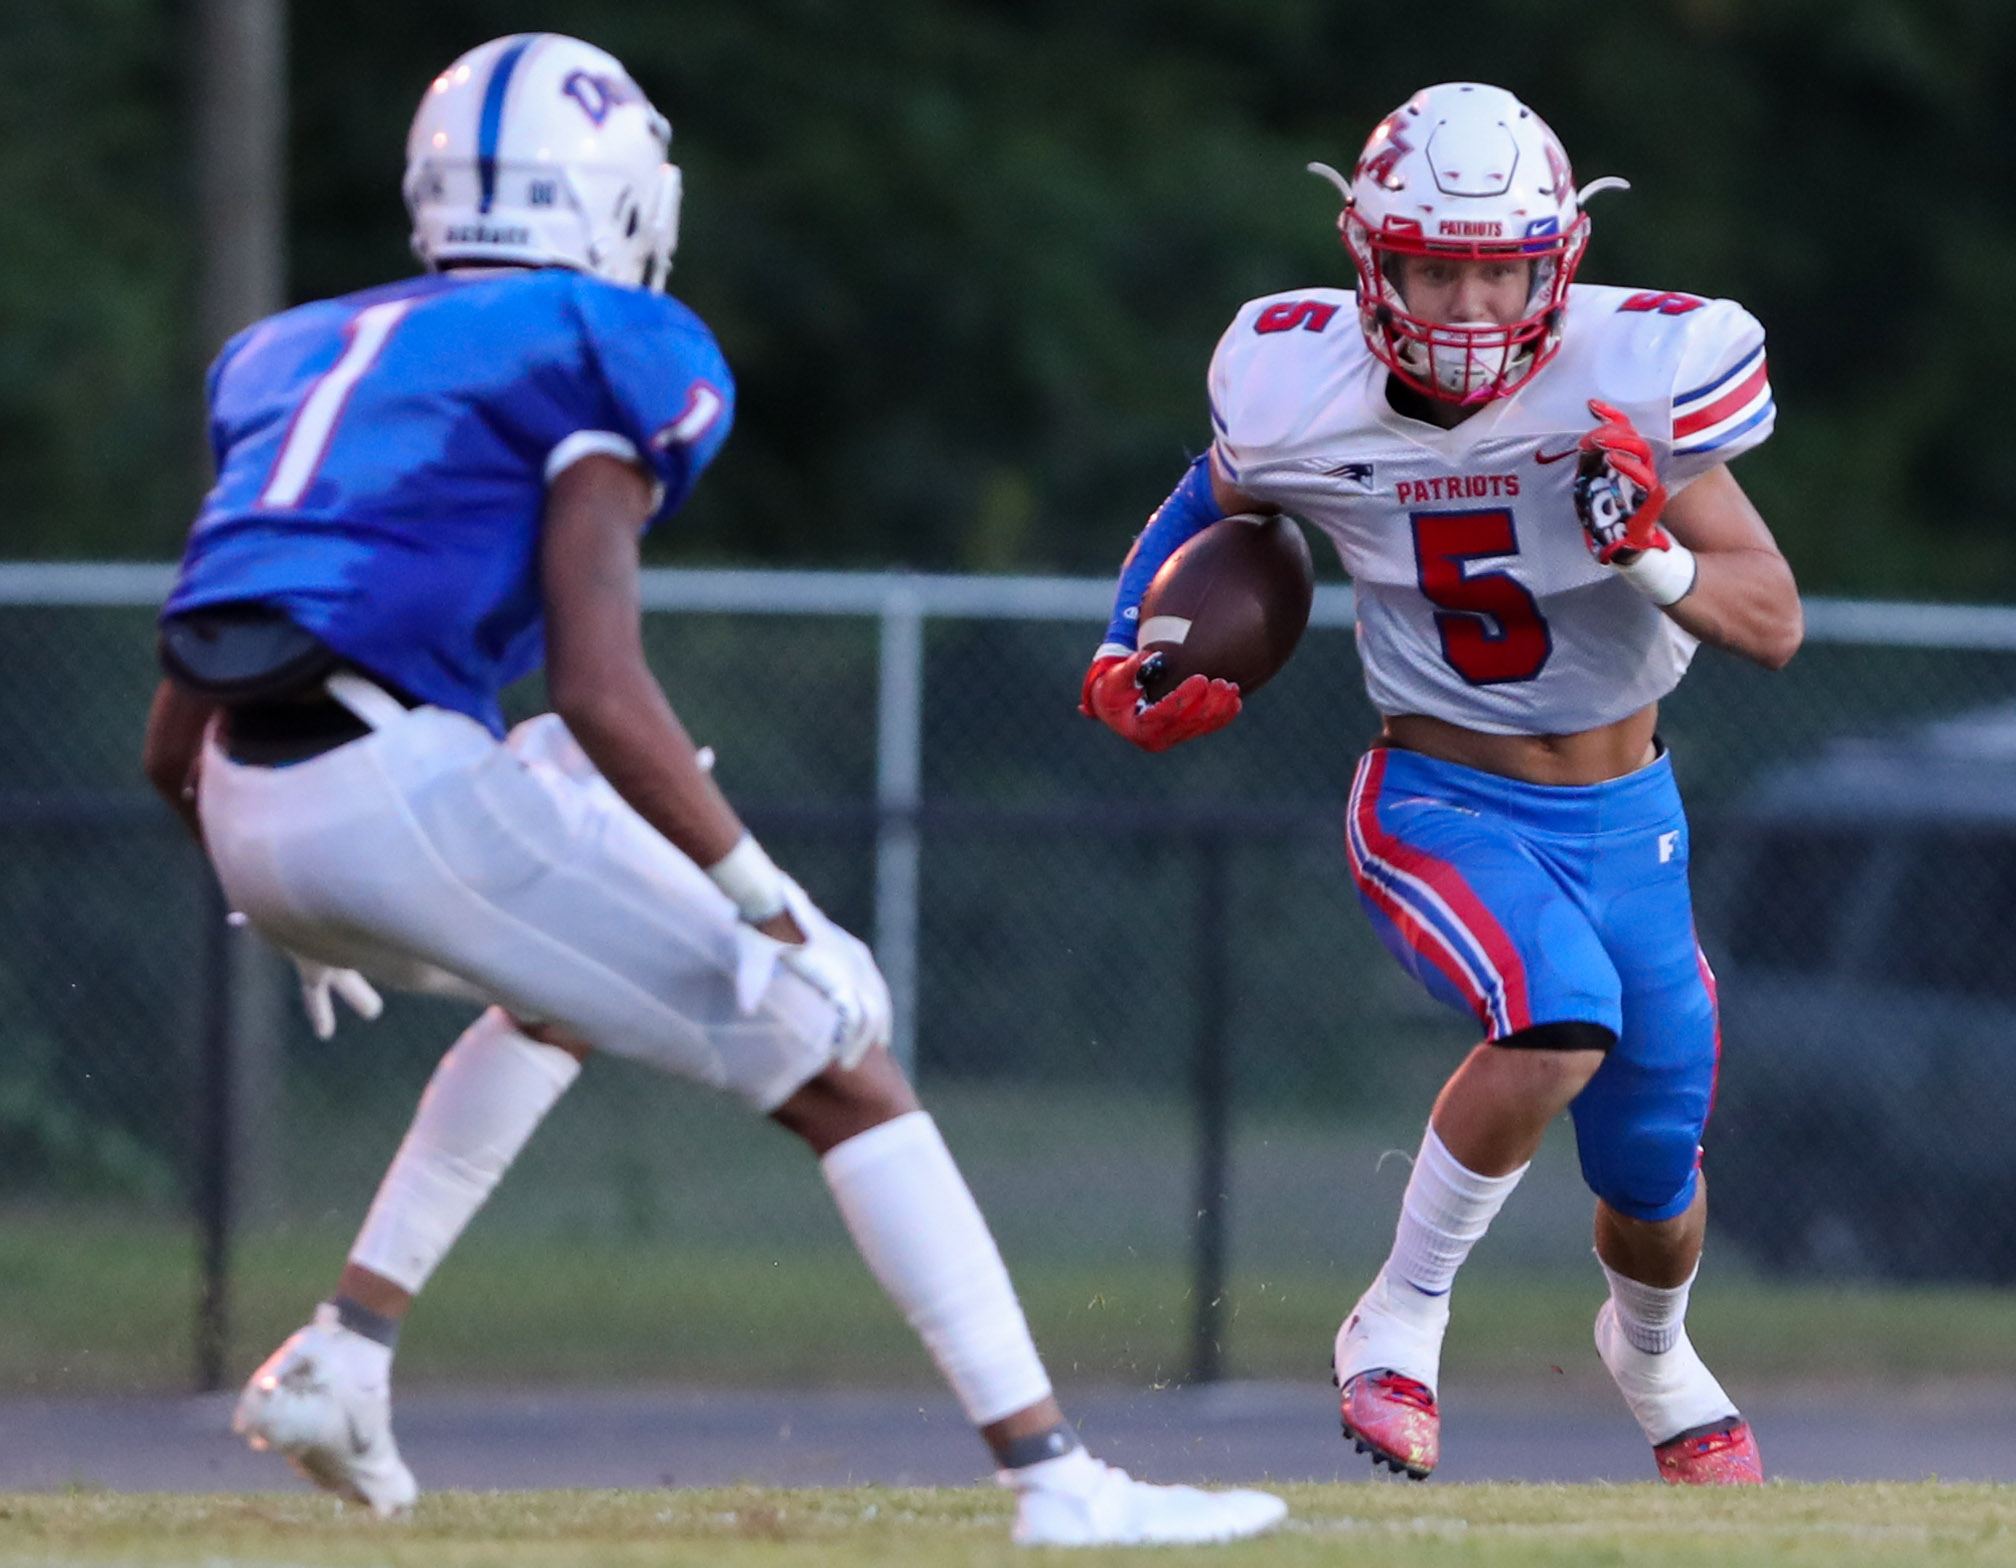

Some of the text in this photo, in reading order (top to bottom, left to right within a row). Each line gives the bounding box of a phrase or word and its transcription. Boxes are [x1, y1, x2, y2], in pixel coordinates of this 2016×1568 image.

[1439, 221, 1503, 237] PATRIOTS
[1253, 299, 1341, 336] 5
[1615, 291, 1706, 316] 5
[254, 297, 420, 511] 1
[649, 379, 725, 450] 1
[1396, 475, 1520, 504] PATRIOTS
[1410, 507, 1553, 685] 5
